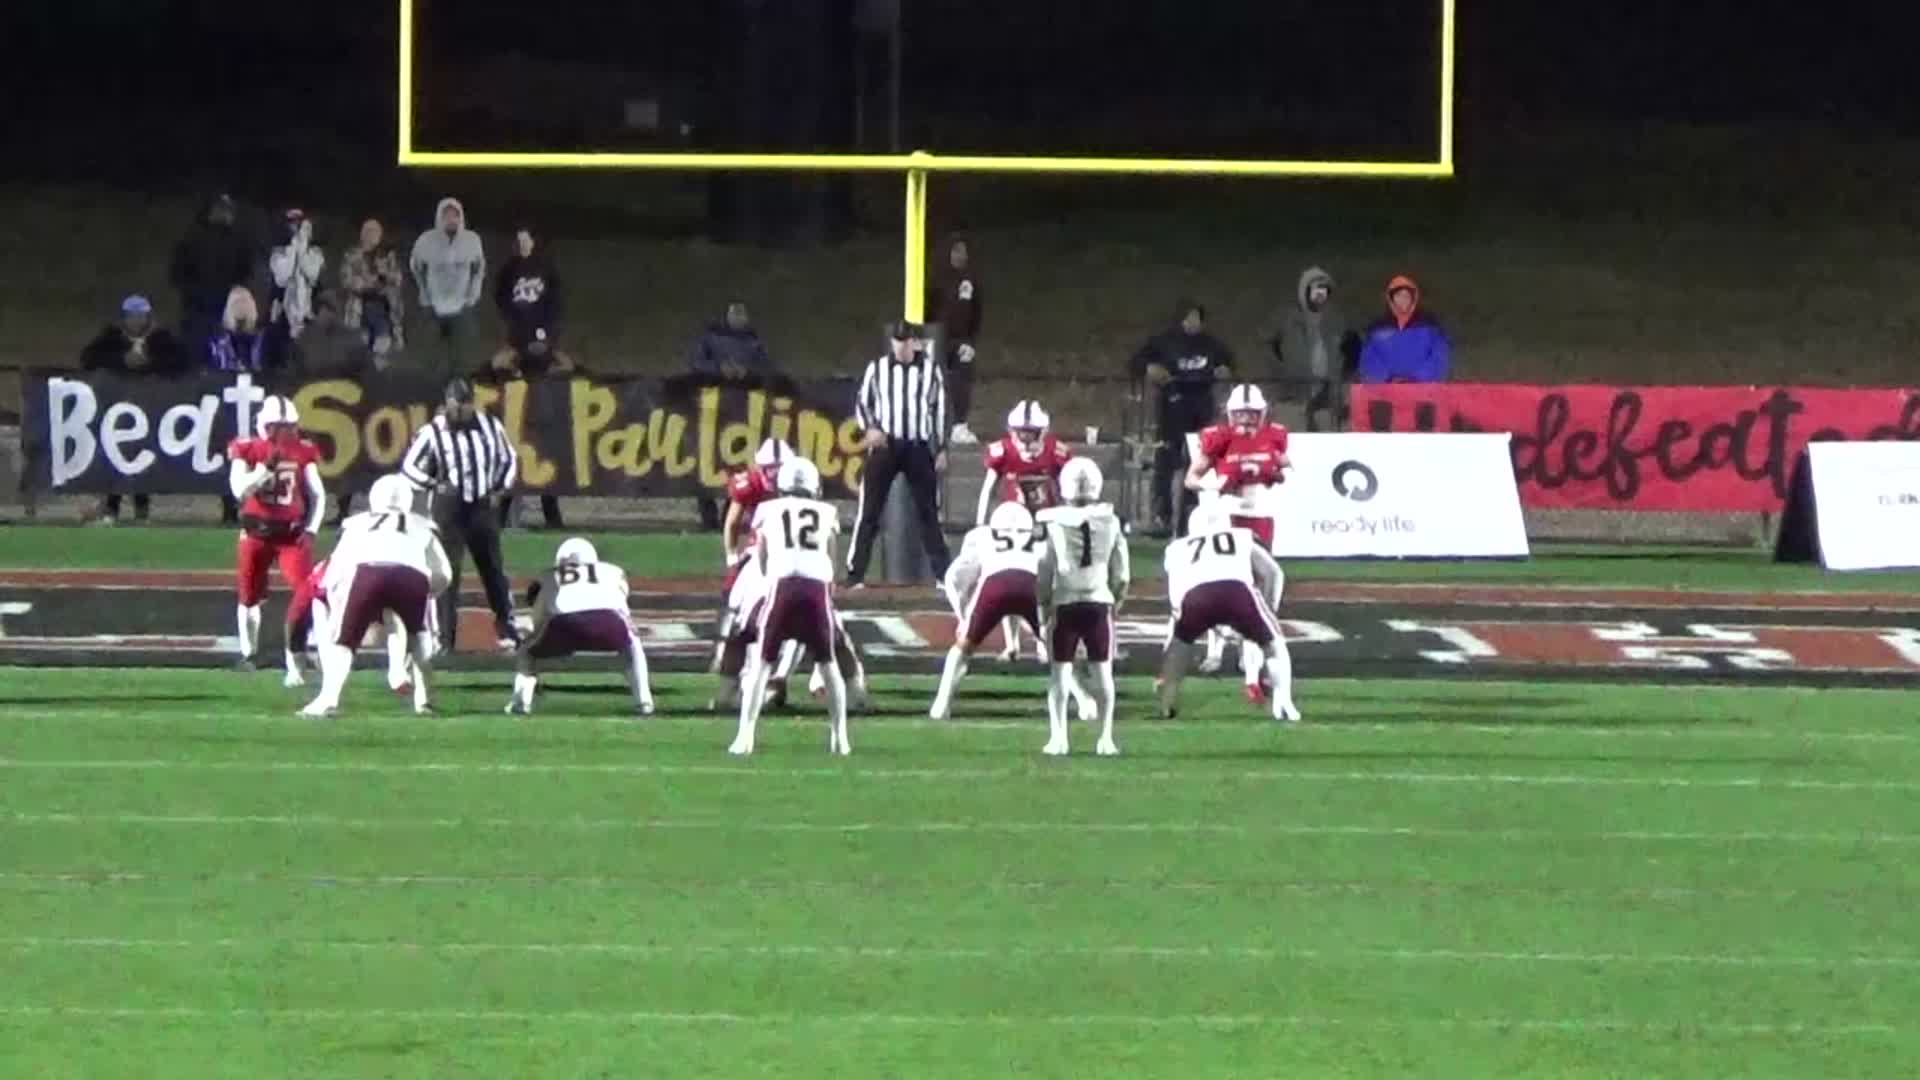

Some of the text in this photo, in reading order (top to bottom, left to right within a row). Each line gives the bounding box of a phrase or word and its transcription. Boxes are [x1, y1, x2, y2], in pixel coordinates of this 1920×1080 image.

[47, 373, 265, 486] Beat
[570, 377, 867, 494] Paulding
[368, 512, 408, 535] 71
[782, 508, 819, 550] 12
[991, 527, 1034, 552] 57
[1311, 514, 1416, 536] ready life
[1080, 520, 1092, 567] 1
[1187, 532, 1236, 564] 70
